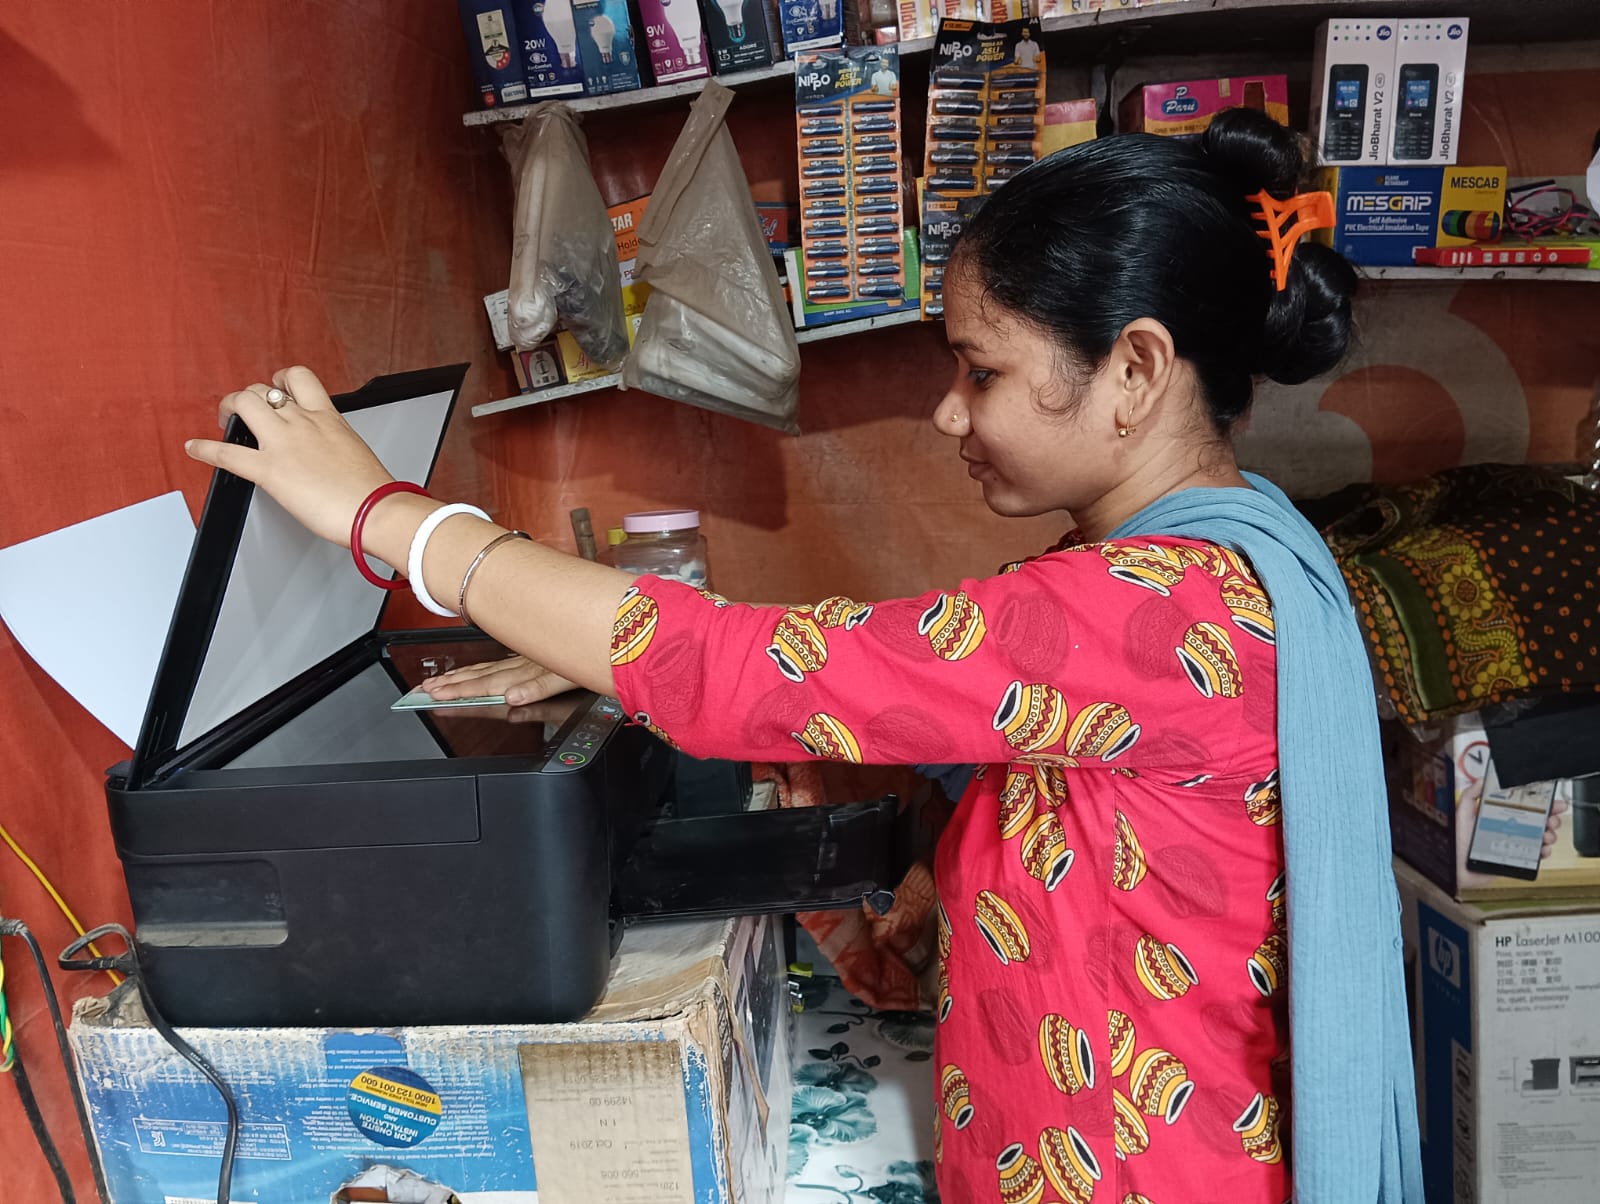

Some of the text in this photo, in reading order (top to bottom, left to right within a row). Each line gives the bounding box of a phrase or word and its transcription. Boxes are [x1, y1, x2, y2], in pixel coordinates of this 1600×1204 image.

[646, 24, 665, 37] 9W
[1378, 28, 1391, 37] Jio
[1449, 27, 1462, 36] Jio
[524, 38, 546, 50] 20W
[940, 41, 973, 61] NIPPO
[982, 46, 1000, 54] ASLI
[976, 52, 1005, 62] POWER
[798, 73, 831, 91] NIPPO
[834, 78, 862, 88] POWER
[1374, 90, 1384, 105] V2
[1440, 90, 1454, 160] JioBharat V2
[1369, 108, 1383, 160] JioBharat
[1451, 176, 1500, 189] MESCAB
[1346, 196, 1432, 212] MESGRIP
[610, 212, 633, 232] TAR
[1368, 216, 1380, 224] Self
[928, 221, 961, 240] NIPPO
[1416, 224, 1429, 232] Tape
[1496, 932, 1600, 948] HP LaserJet M100
[361, 1076, 436, 1105] 1800 123 001 600
[350, 1094, 437, 1126] CUSTOMER SERVICE
[359, 1113, 419, 1137] INSTALLATION
[383, 1114, 398, 1122] AND
[361, 1122, 412, 1142] FOR ONSITE
[569, 1140, 612, 1150] Oct 2019
